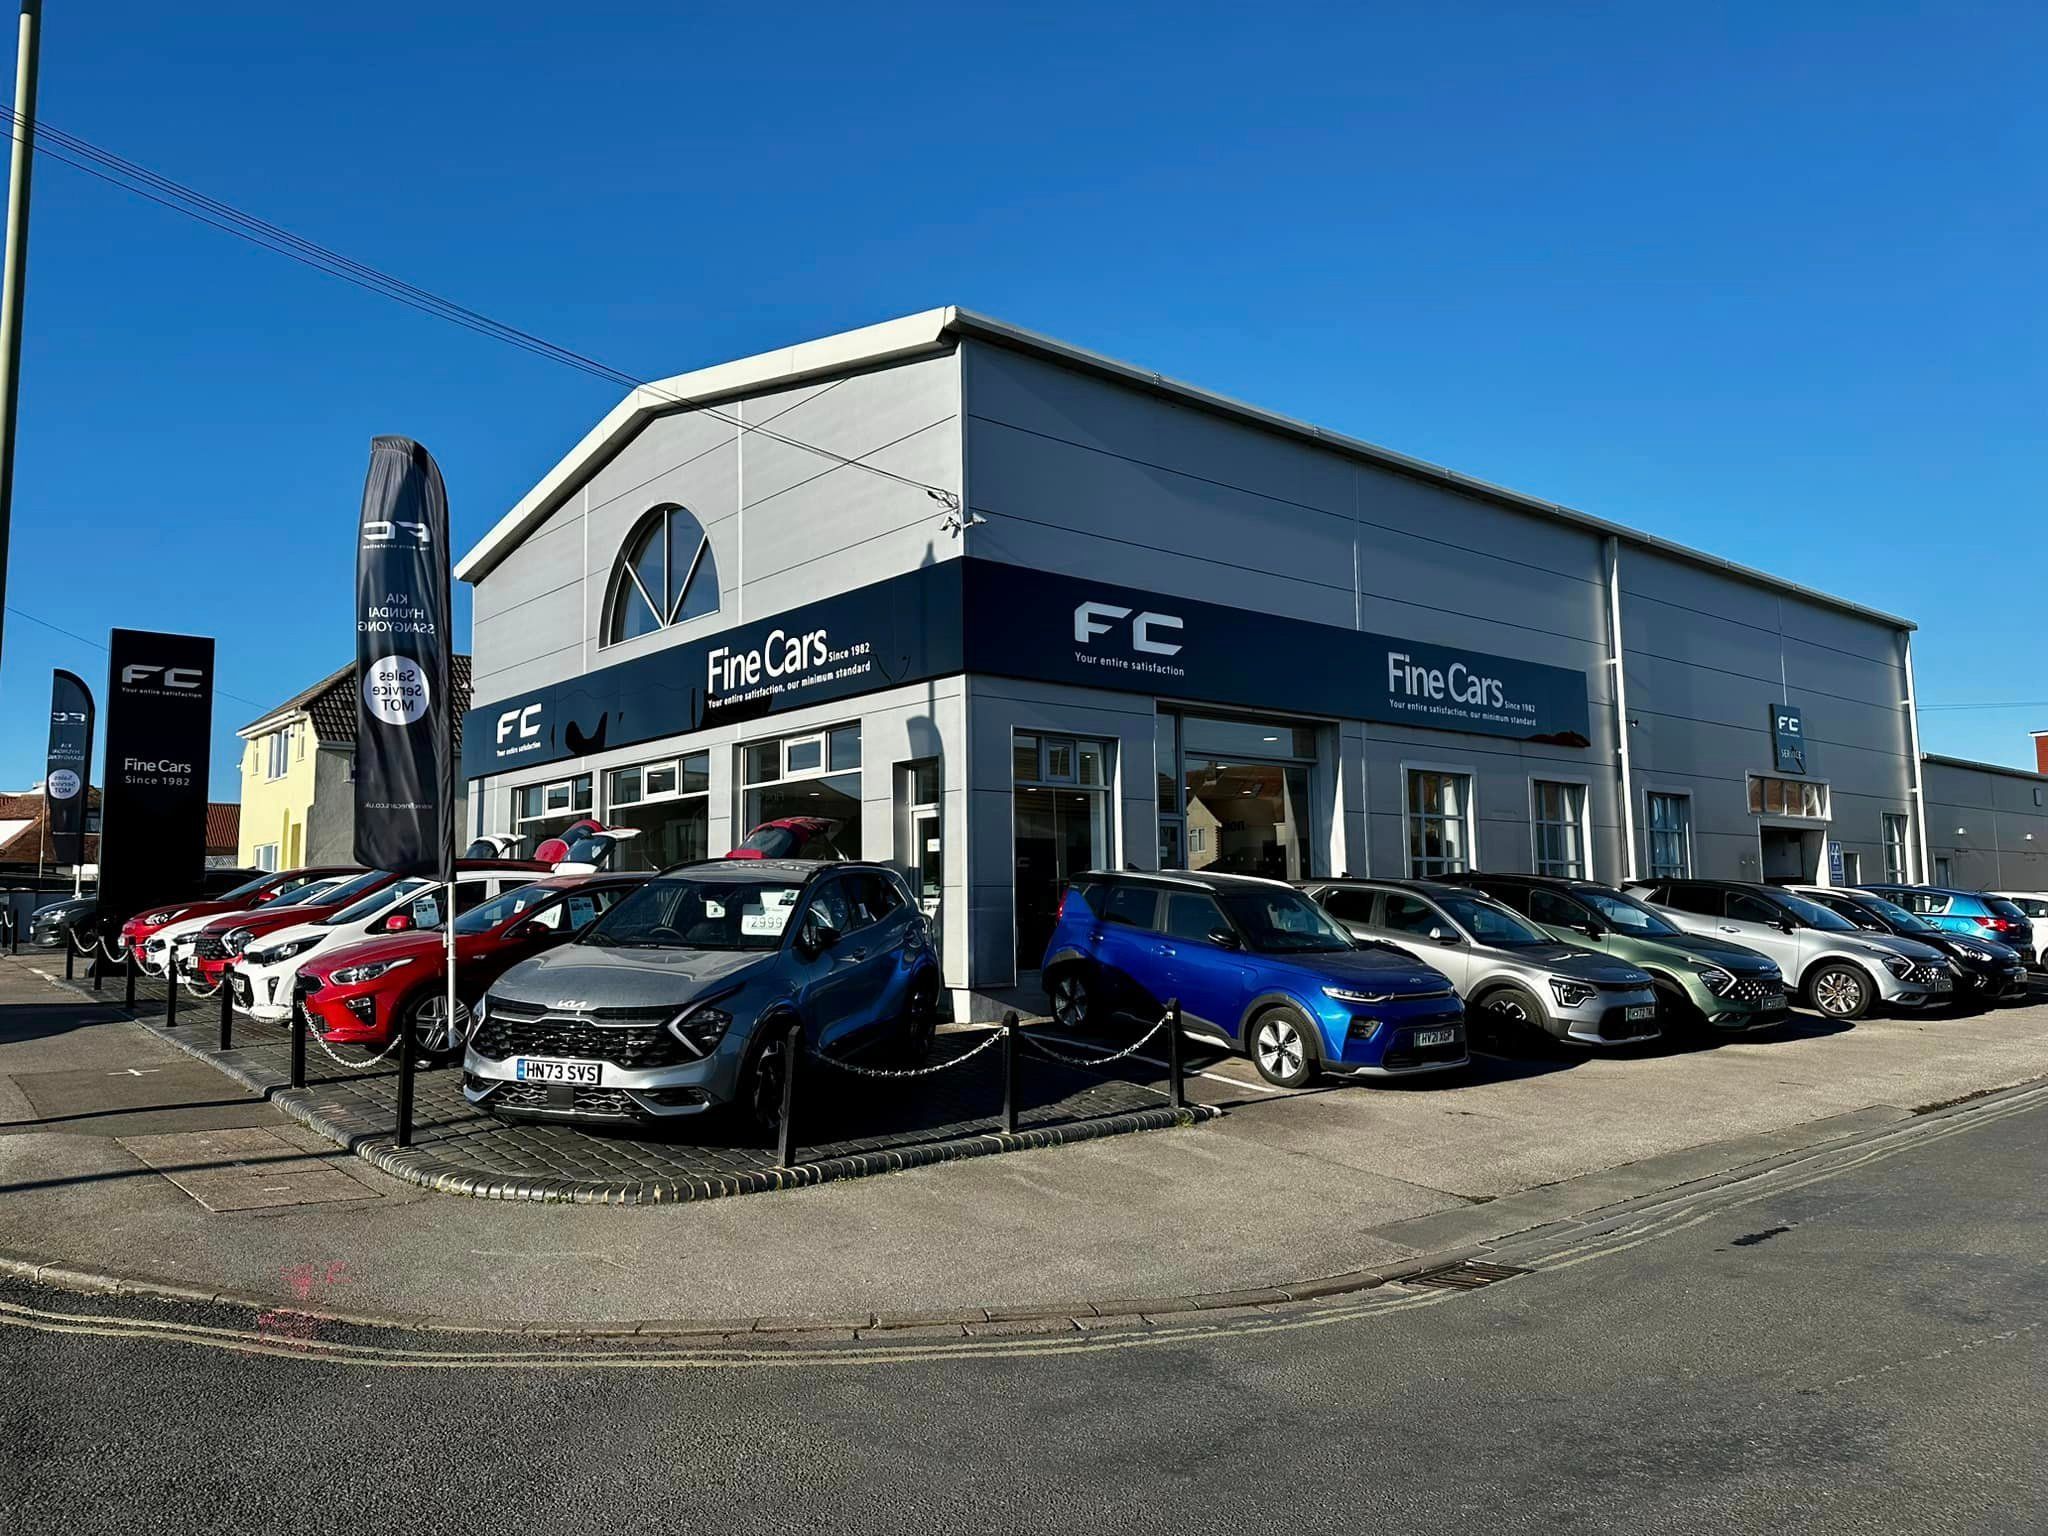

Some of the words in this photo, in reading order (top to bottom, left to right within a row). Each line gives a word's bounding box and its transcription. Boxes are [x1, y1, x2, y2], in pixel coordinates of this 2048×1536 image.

[1074, 600, 1184, 656] FC
[707, 645, 762, 695] Fine
[764, 629, 829, 678] Cars
[828, 650, 849, 663] Since
[851, 642, 871, 657] 1982
[1075, 651, 1097, 664] Your
[1100, 656, 1129, 669] entire
[1131, 661, 1185, 677] satisfaction
[122, 664, 203, 688] FC
[708, 699, 723, 709] Your
[724, 693, 743, 706] entire
[744, 684, 786, 701] satisfaction,
[787, 679, 800, 691] our
[801, 670, 834, 688] minimum
[835, 660, 871, 680] standard
[1388, 651, 1446, 700] Fine
[1447, 662, 1505, 709] Cars
[1504, 700, 1521, 712] Since
[1521, 703, 1536, 713] 1982
[162, 690, 202, 698] satisfaction
[497, 703, 542, 744] FC
[1389, 698, 1406, 710] Your
[1407, 702, 1428, 713] entire
[1429, 705, 1469, 719] satisfaction,
[1470, 710, 1481, 719] our
[1482, 712, 1510, 724] minimum
[1511, 715, 1537, 727] standard
[1778, 716, 1799, 732] FC
[124, 757, 157, 772] Fine
[158, 759, 192, 774] Cars
[125, 775, 158, 785] Since
[162, 776, 190, 786] 1982
[526, 1061, 563, 1080] HN73
[567, 1065, 596, 1082] SVS
